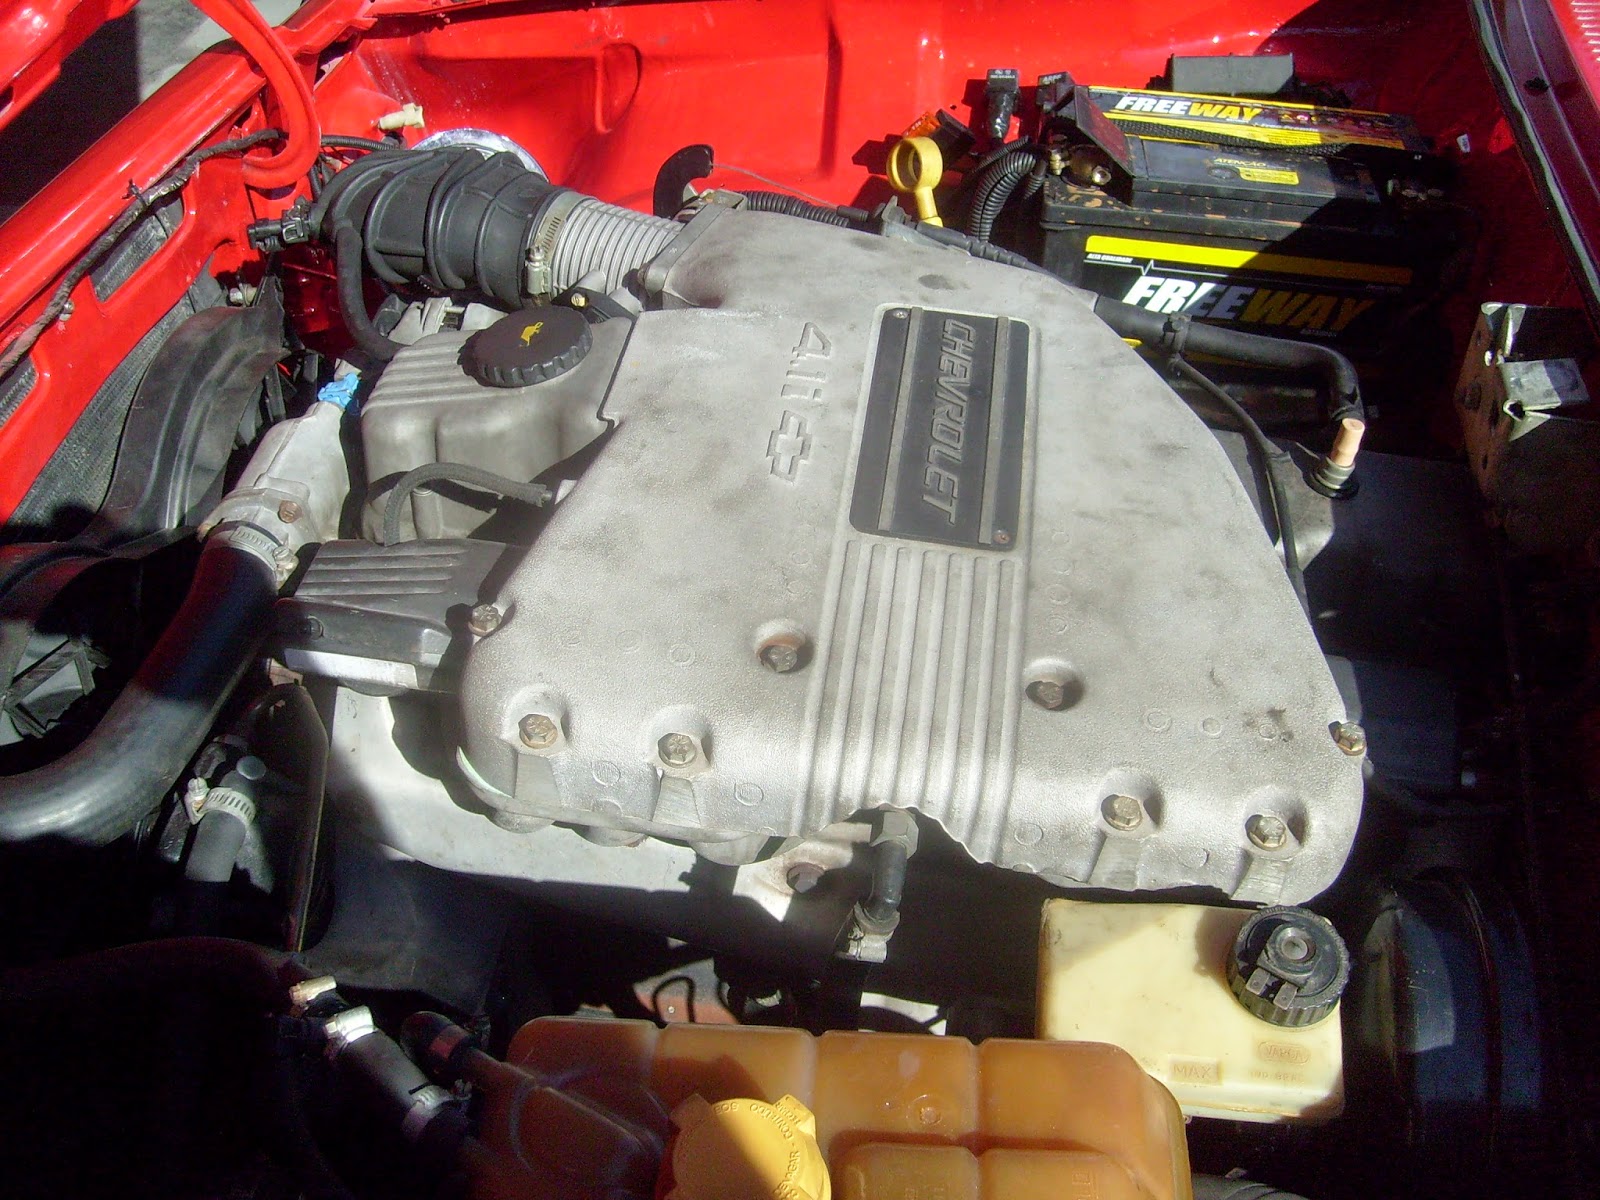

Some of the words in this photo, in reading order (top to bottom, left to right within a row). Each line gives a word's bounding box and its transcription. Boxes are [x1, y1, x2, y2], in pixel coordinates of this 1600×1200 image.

[1115, 95, 1262, 121] FREEWAY
[1122, 275, 1377, 331] FREEWAY
[922, 318, 976, 525] CHEVROLET
[1173, 1063, 1212, 1079] MAX
